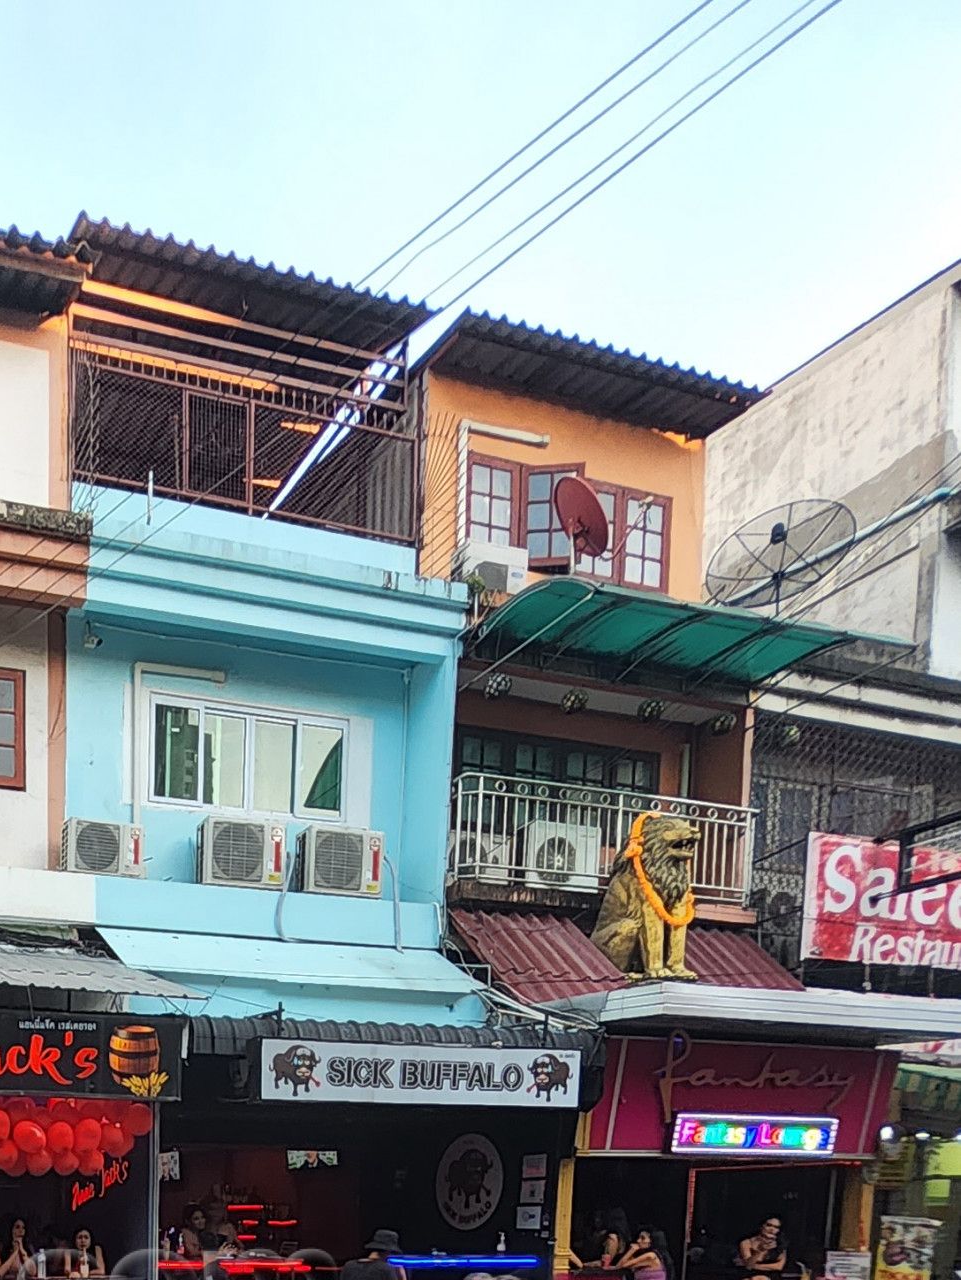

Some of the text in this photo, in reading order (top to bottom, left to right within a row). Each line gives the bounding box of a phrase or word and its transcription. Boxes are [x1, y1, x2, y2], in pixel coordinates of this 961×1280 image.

[326, 1056, 524, 1092] SICK BUFFALO
[681, 1120, 758, 1148] Fantasy
